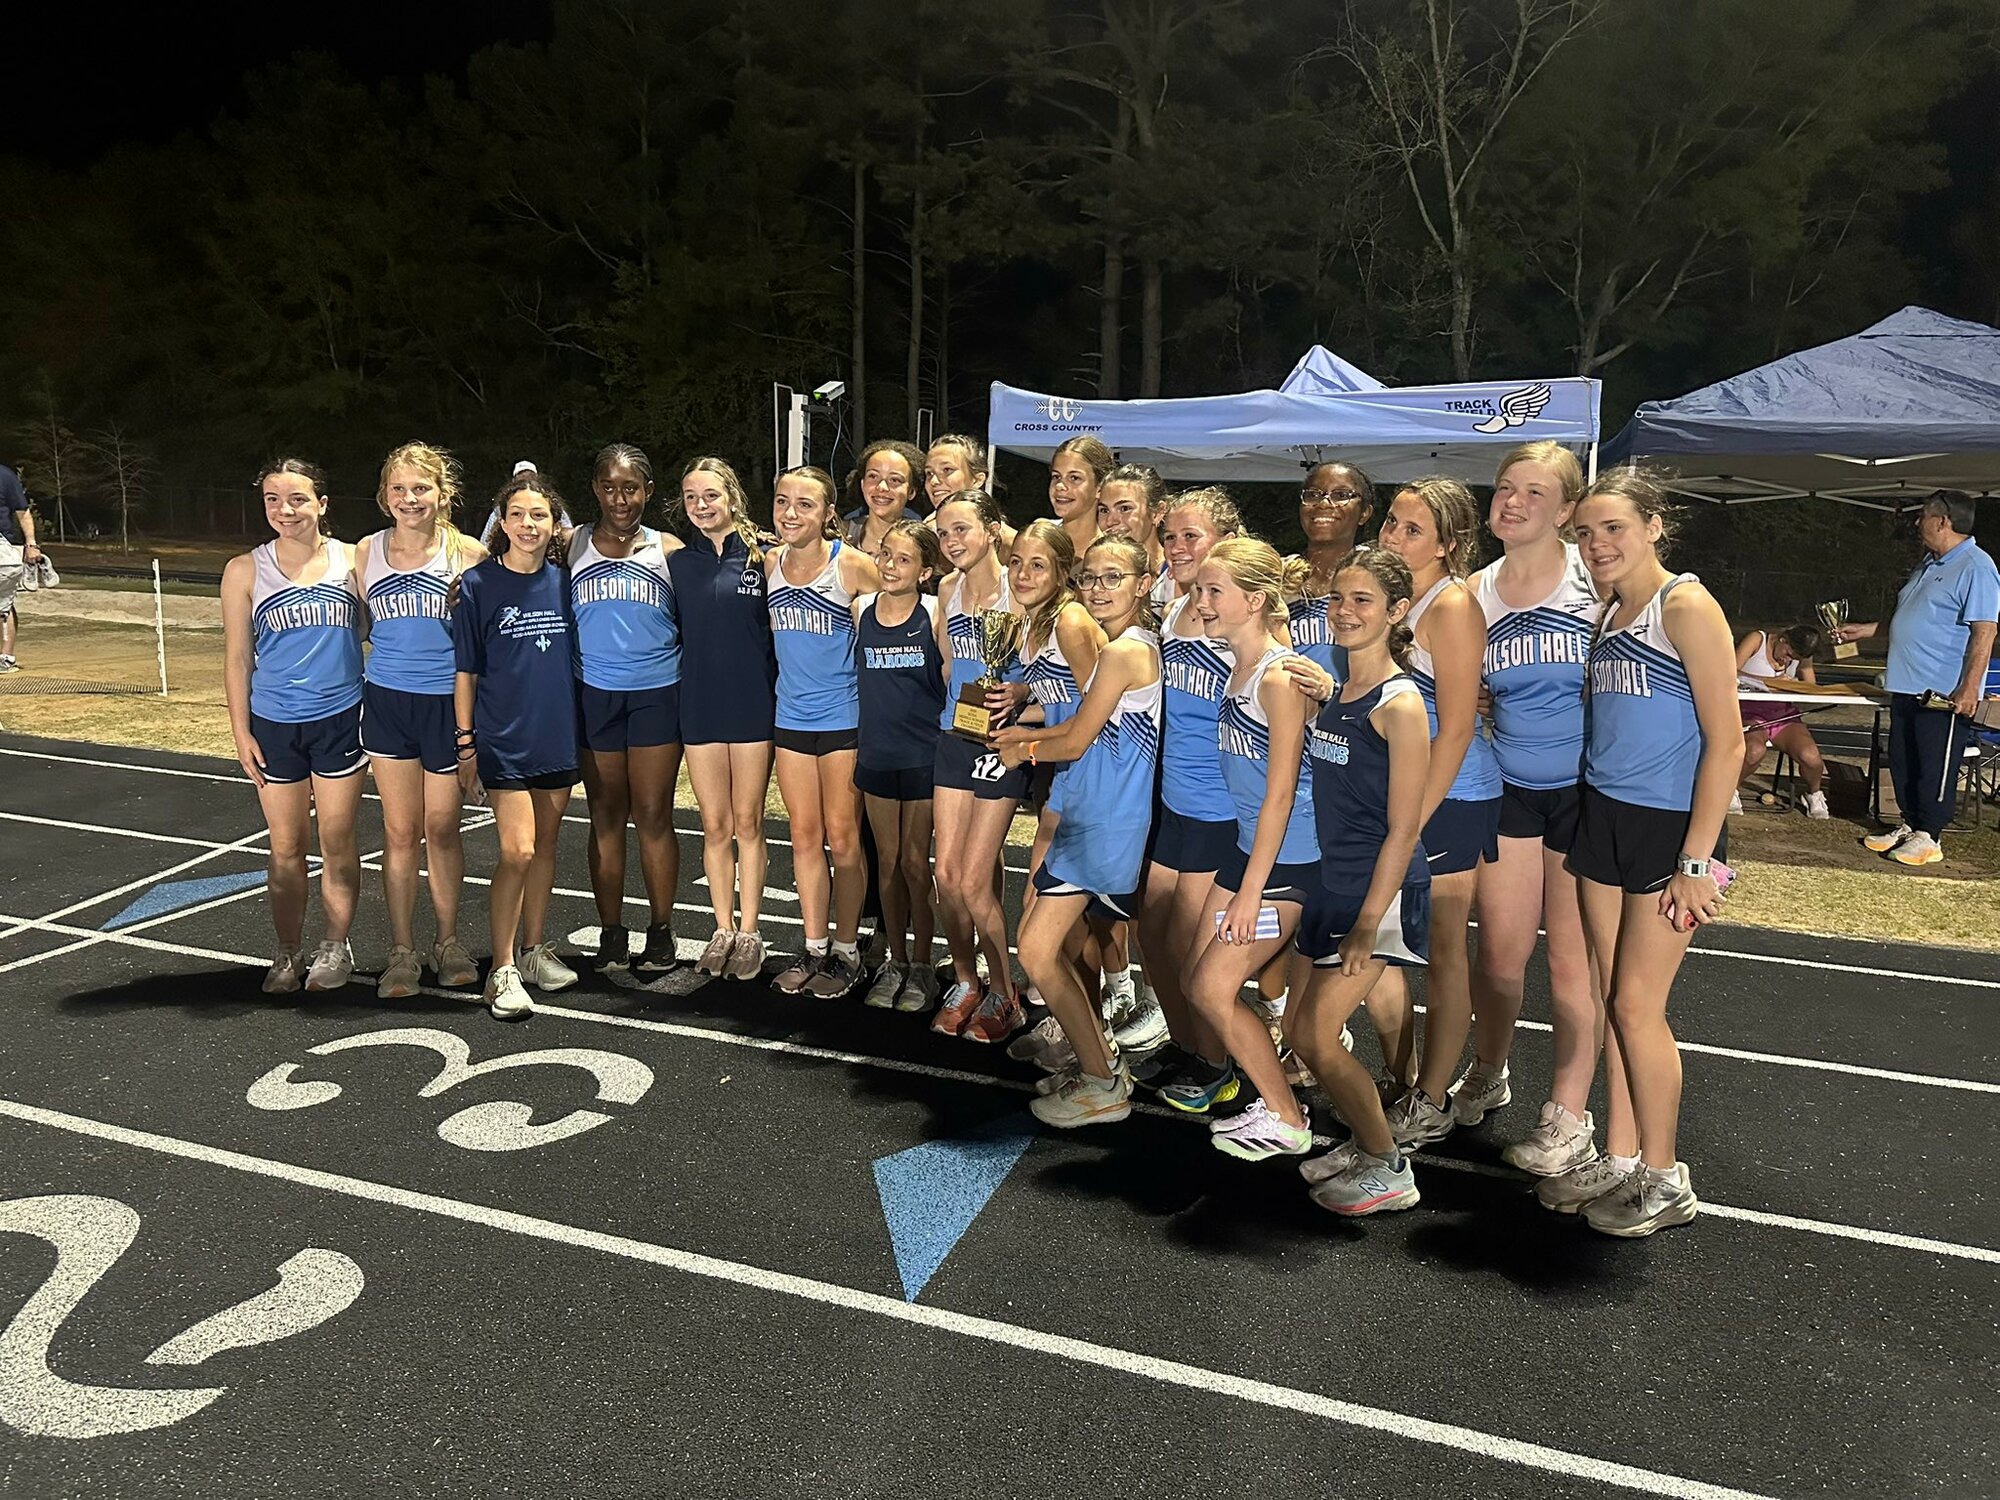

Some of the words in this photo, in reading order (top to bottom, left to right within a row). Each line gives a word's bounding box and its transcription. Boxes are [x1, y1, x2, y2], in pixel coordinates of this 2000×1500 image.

[1444, 399, 1493, 411] TRACK
[1014, 423, 1049, 432] CROSS
[1051, 424, 1103, 432] COUNTRY
[369, 592, 418, 622] WILSON
[577, 577, 627, 606] WILSON
[630, 578, 661, 608] HALL
[265, 601, 322, 633] WILSON
[804, 608, 834, 637] HALL
[1290, 617, 1321, 647] SON
[864, 647, 925, 669] BARONS
[874, 647, 903, 655] WILSON
[1540, 632, 1586, 665] HALL
[1164, 661, 1186, 691] SON
[1186, 664, 1219, 703] HALL
[1594, 659, 1612, 693] SON
[1613, 659, 1652, 698] HALL
[977, 755, 1001, 780] 12
[246, 1027, 655, 1152] 3
